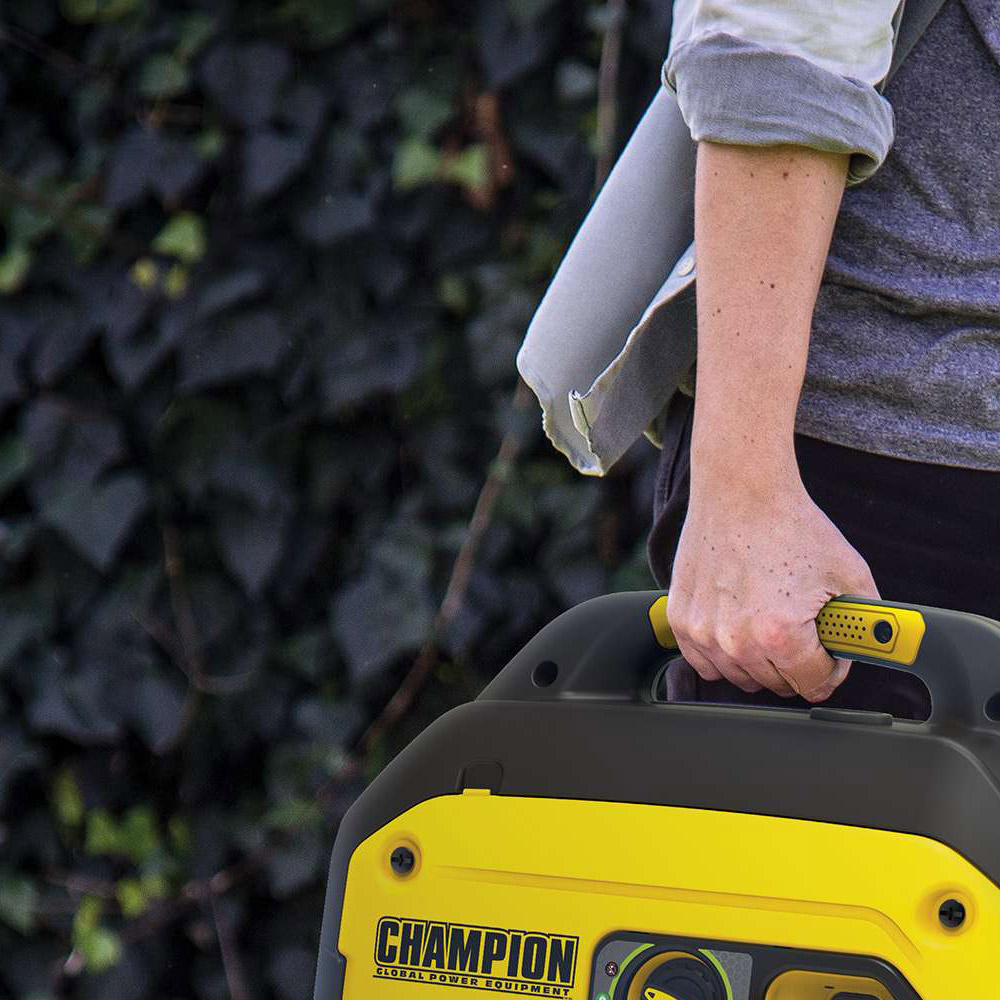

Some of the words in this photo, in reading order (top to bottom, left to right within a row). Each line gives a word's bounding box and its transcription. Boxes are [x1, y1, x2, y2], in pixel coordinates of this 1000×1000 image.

[376, 919, 578, 985] CHAMPION
[376, 967, 424, 981] GLOBAL
[429, 972, 478, 987] POWER
[485, 979, 570, 997] EQUIPMENT
